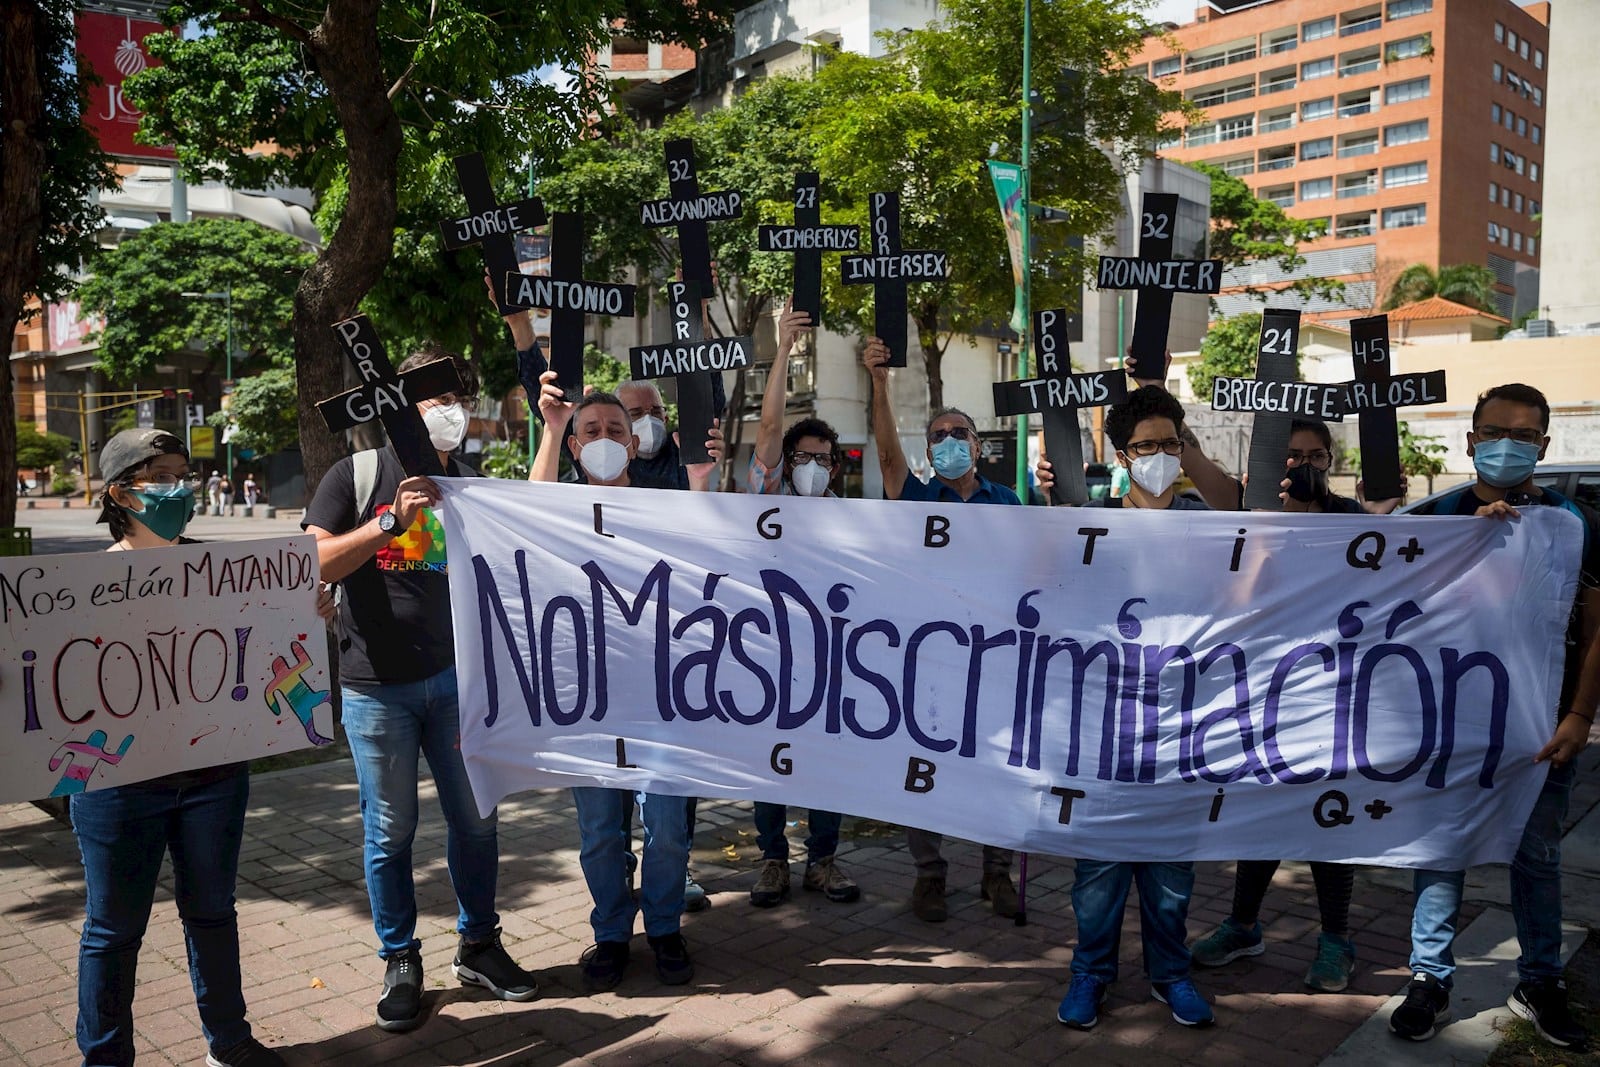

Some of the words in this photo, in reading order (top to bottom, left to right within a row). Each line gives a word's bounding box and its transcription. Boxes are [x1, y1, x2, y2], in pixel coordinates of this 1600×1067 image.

[669, 159, 692, 182] 32
[795, 187, 816, 208] 27
[456, 207, 520, 241] JORGE
[874, 192, 890, 255] POR
[1142, 213, 1169, 239] 32
[846, 253, 946, 280] INTERSEX
[1101, 258, 1214, 291] RONNIE.R
[517, 278, 622, 314] ANTONIO
[673, 283, 690, 340] POR
[337, 320, 381, 382] POR
[641, 341, 747, 376] MARICO/A
[1040, 311, 1058, 373] POR
[1261, 328, 1292, 356] 21
[1354, 337, 1386, 365] 45
[346, 379, 409, 422] GAY
[1020, 374, 1109, 409] TRANS
[593, 503, 615, 538] L
[756, 508, 782, 540] G
[924, 515, 950, 547] B
[1077, 527, 1108, 565] T
[0, 567, 76, 623] Nos
[90, 565, 173, 606] están
[183, 549, 314, 597] MATANDO,
[22, 626, 252, 733] ¡COÑO!
[616, 738, 637, 769] L
[770, 743, 793, 775] G
[905, 757, 936, 794] B
[1050, 786, 1086, 825] T
